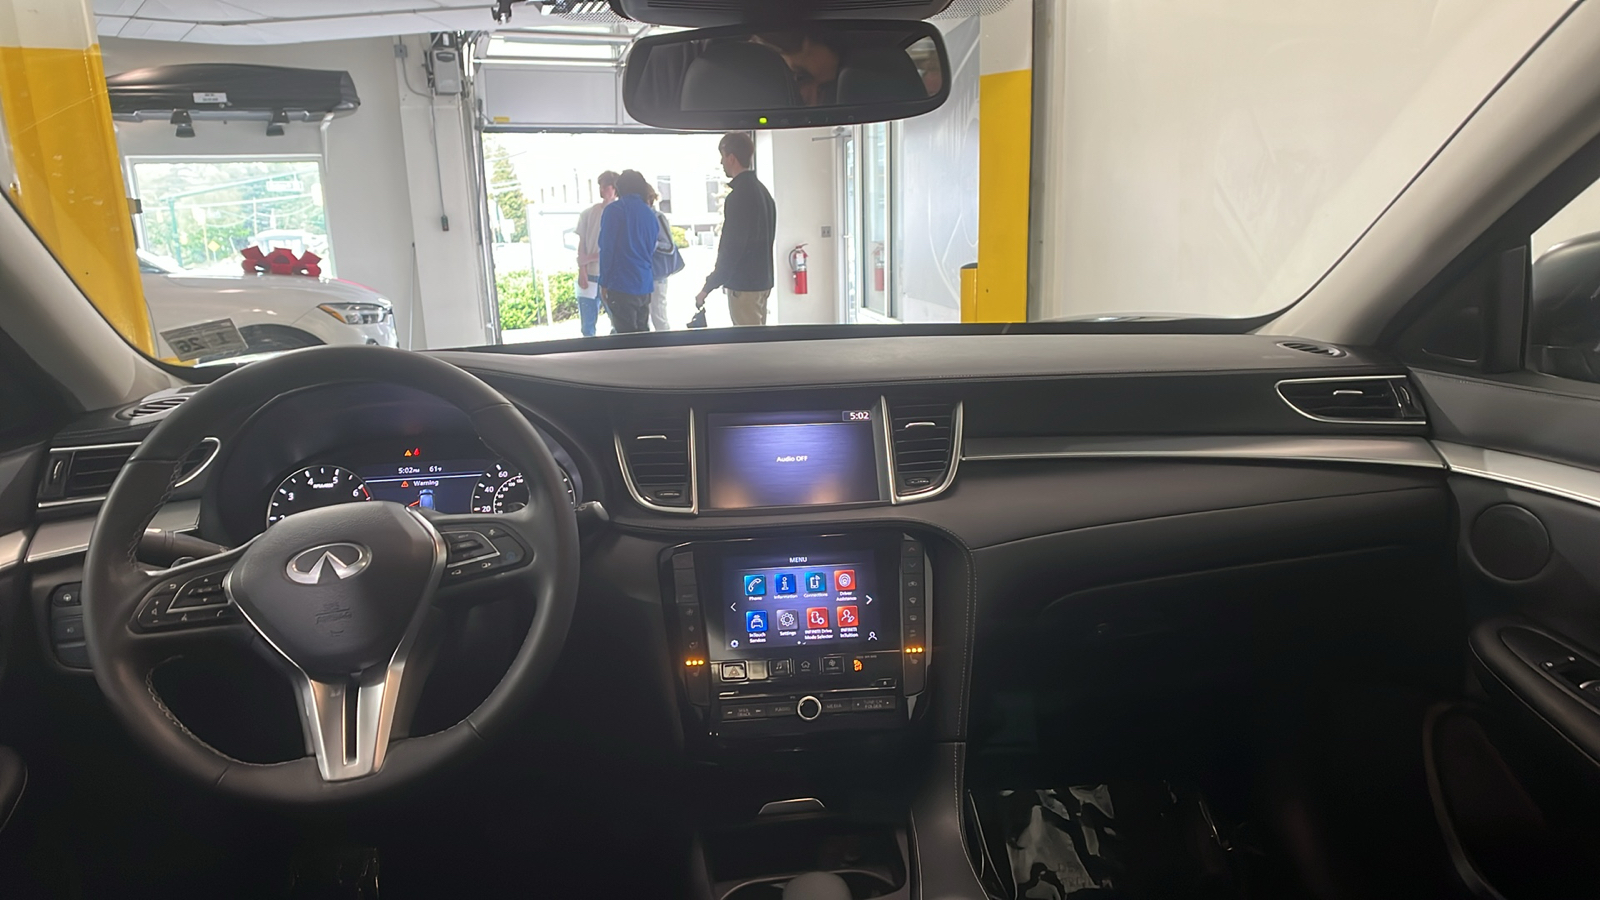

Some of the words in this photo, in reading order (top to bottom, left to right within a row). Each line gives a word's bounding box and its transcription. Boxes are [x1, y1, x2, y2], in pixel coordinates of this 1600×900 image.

[850, 411, 870, 420] 5:02
[776, 455, 795, 463] Audio
[498, 470, 508, 478] 60
[307, 477, 314, 486] 4
[332, 476, 339, 484] 5
[287, 492, 294, 501] 3
[352, 489, 359, 497] 6
